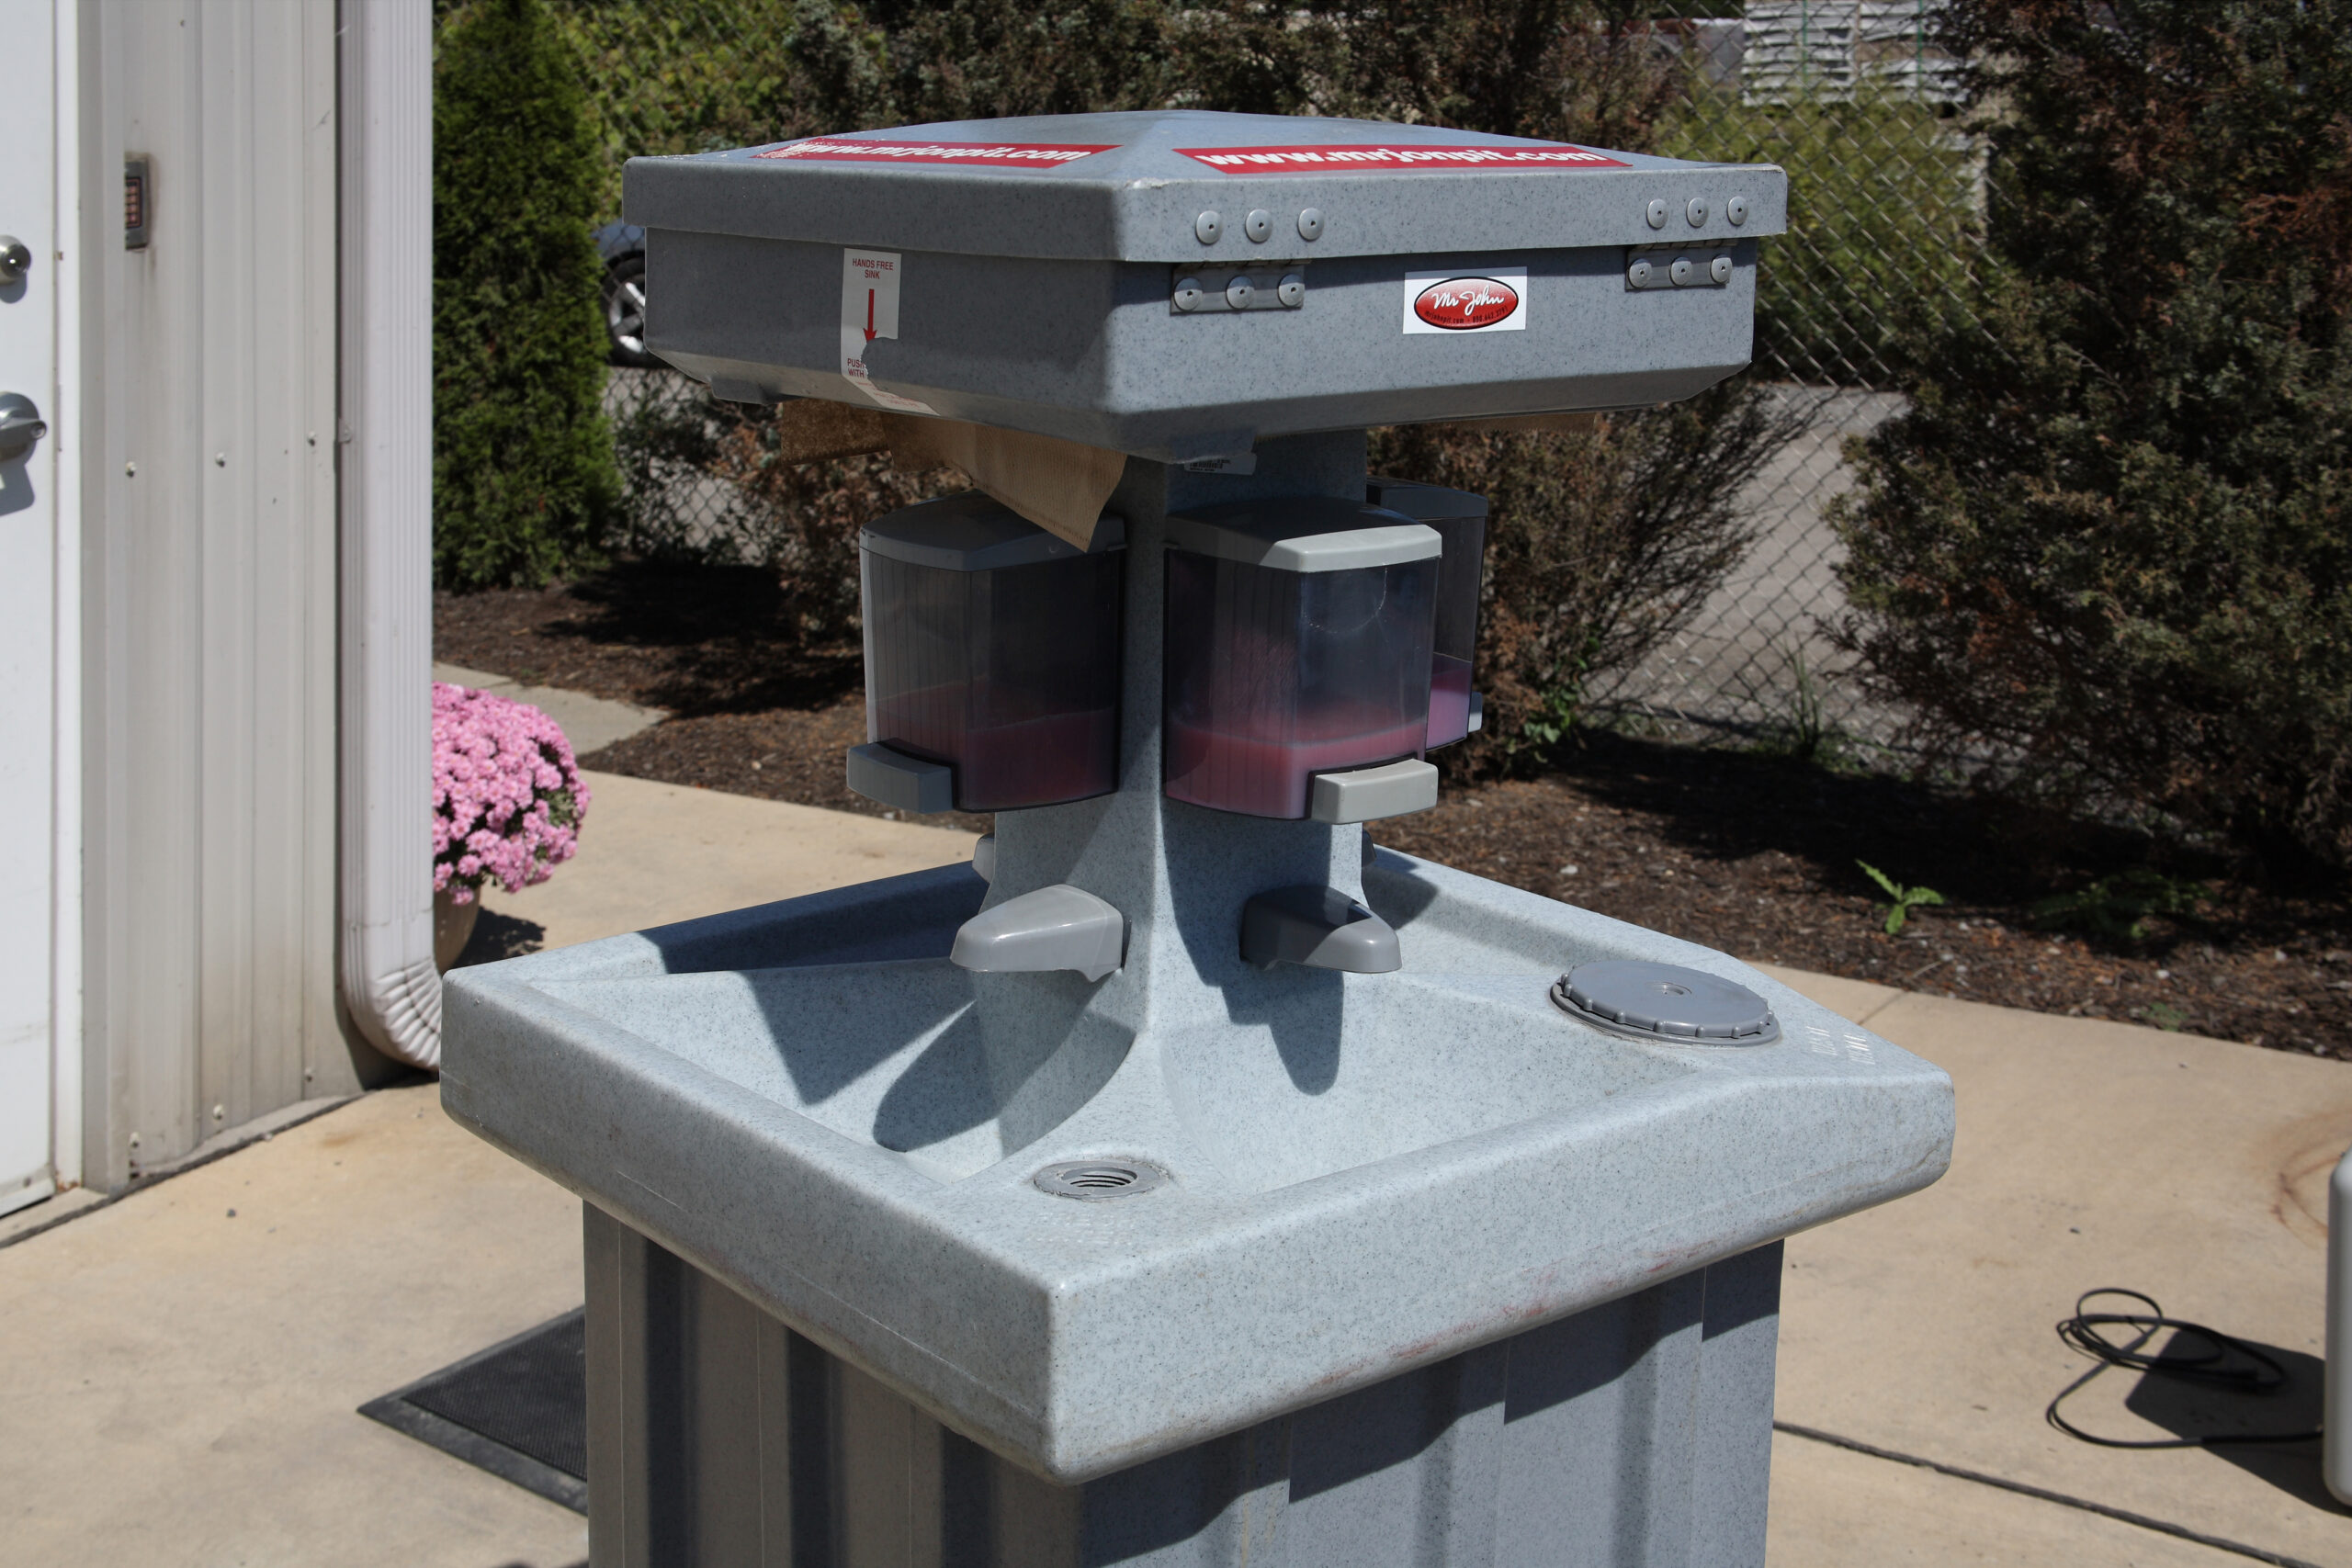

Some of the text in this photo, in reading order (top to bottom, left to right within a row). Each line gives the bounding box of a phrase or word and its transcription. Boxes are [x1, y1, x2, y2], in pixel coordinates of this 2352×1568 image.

[1194, 148, 1607, 165] www.mrjonpit.com
[853, 258, 894, 271] HANDS FREE
[864, 269, 880, 279] SINK
[1431, 285, 1505, 316] Mr John
[847, 368, 865, 378] WITH
